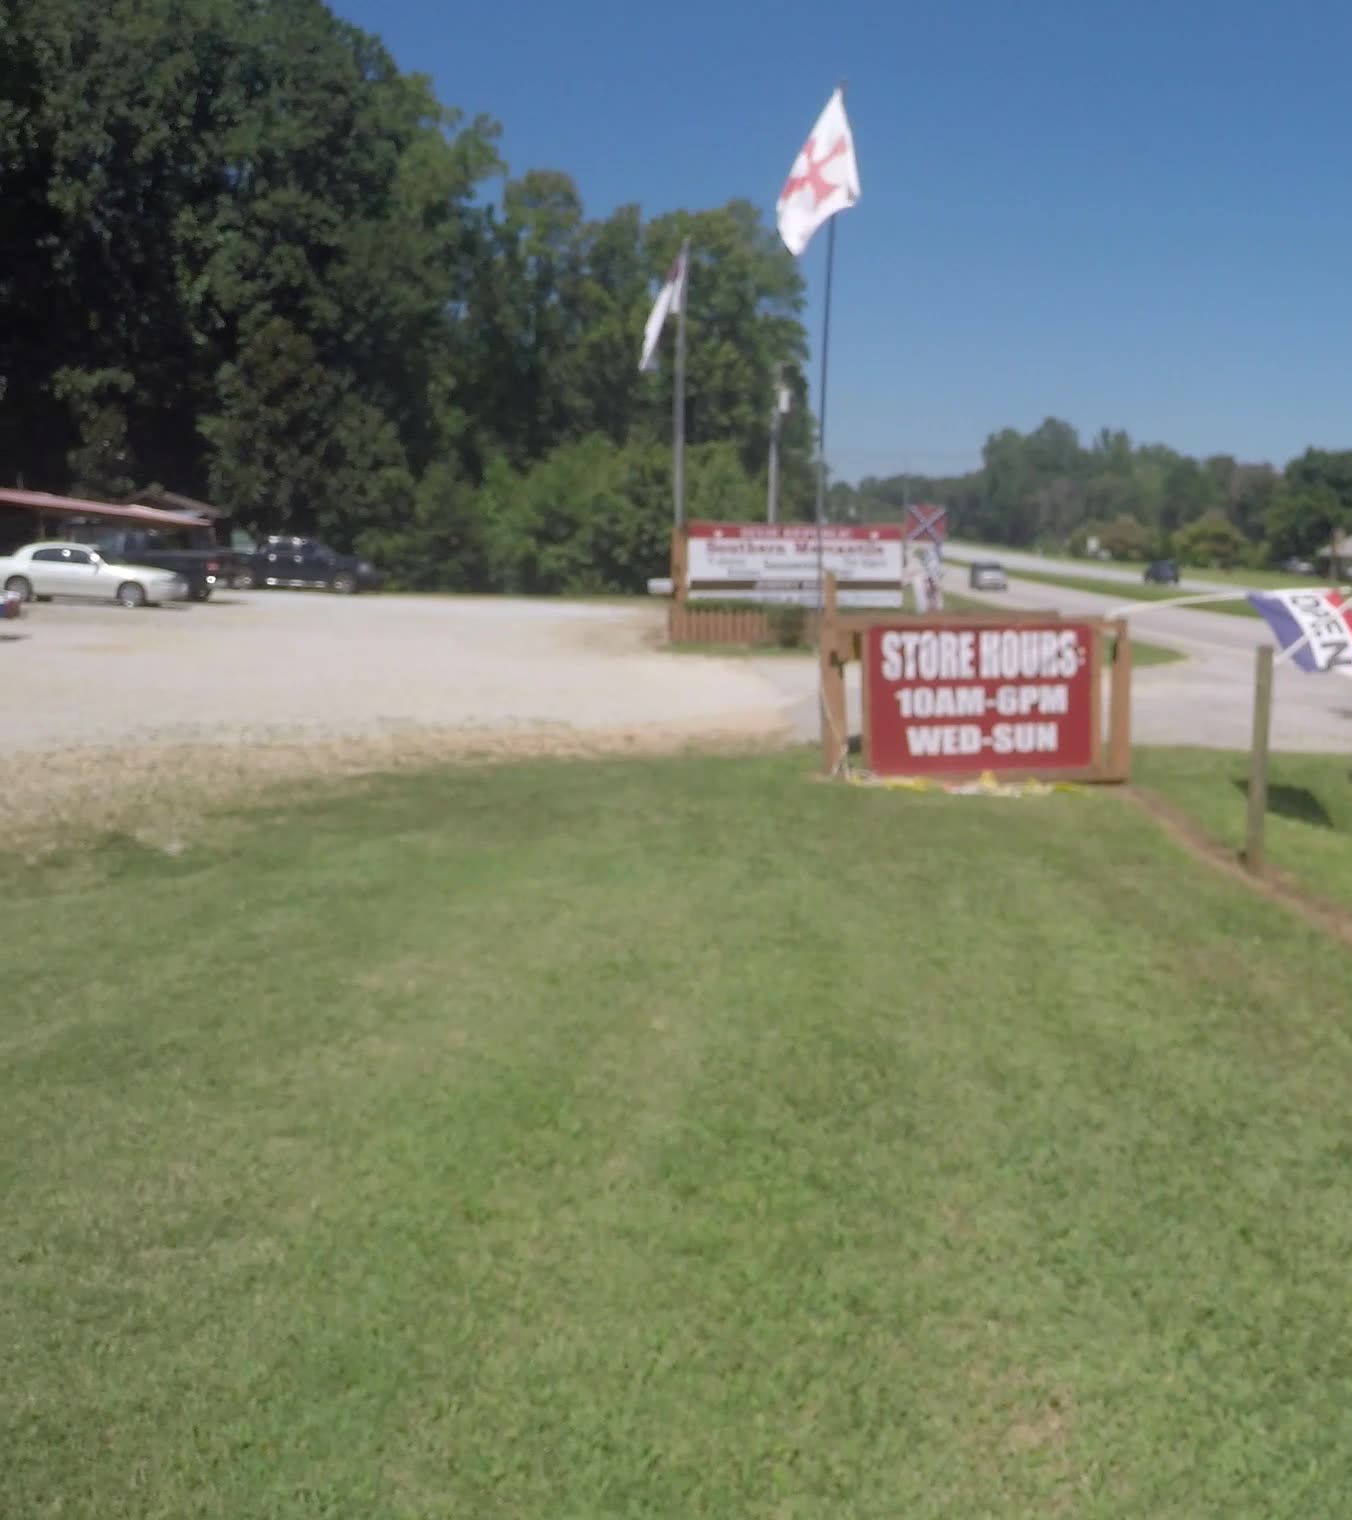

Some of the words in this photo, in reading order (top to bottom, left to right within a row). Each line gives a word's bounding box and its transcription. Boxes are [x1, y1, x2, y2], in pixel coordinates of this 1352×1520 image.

[881, 630, 975, 681] STORE
[979, 628, 1086, 679] HOURS:
[895, 684, 1068, 718] 10AM-6PM
[906, 721, 1058, 756] WED-SUN
